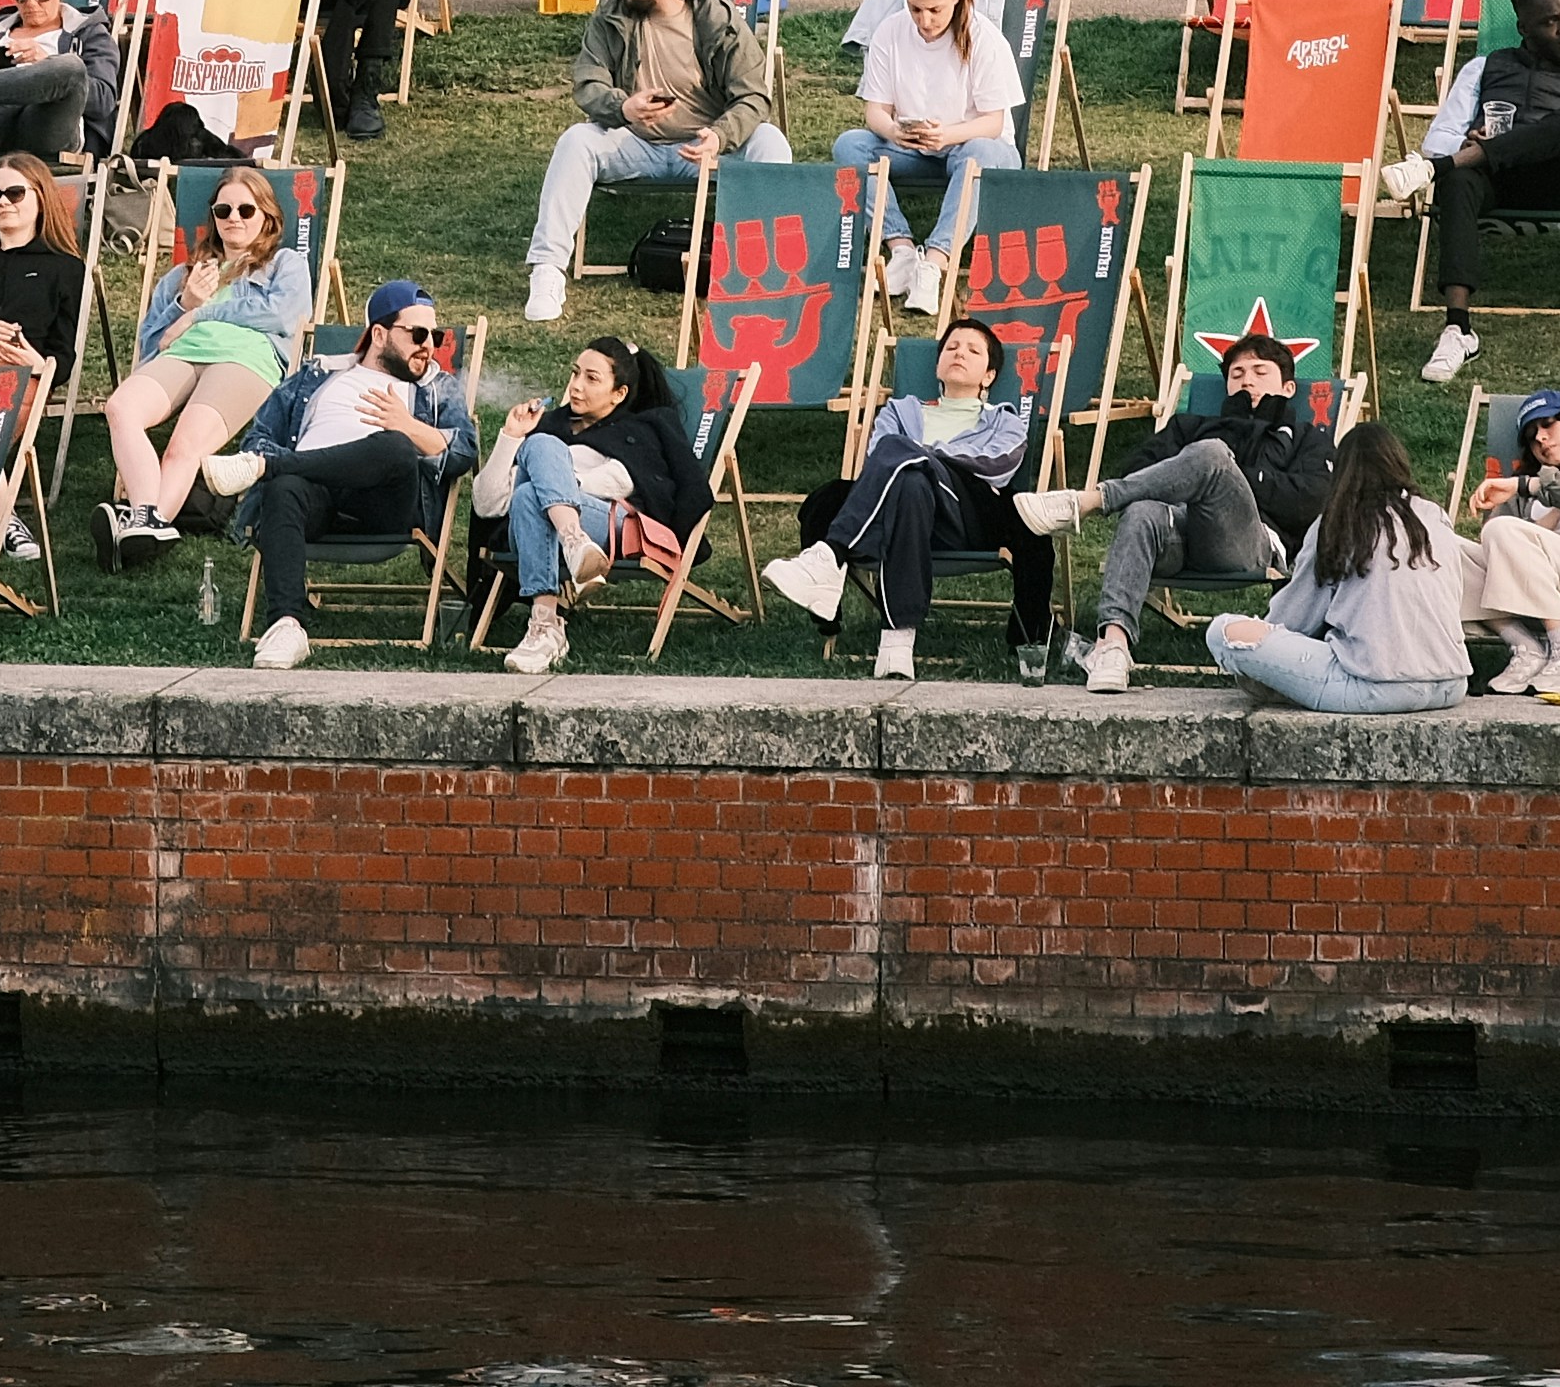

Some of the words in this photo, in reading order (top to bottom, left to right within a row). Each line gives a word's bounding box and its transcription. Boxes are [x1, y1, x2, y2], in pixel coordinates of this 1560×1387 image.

[1019, 8, 1038, 58] BERLINER
[1286, 34, 1349, 62] APEROL
[1296, 50, 1339, 69] SPRITZ
[836, 214, 854, 269] BERLINER
[1095, 226, 1114, 278] BERLINER
